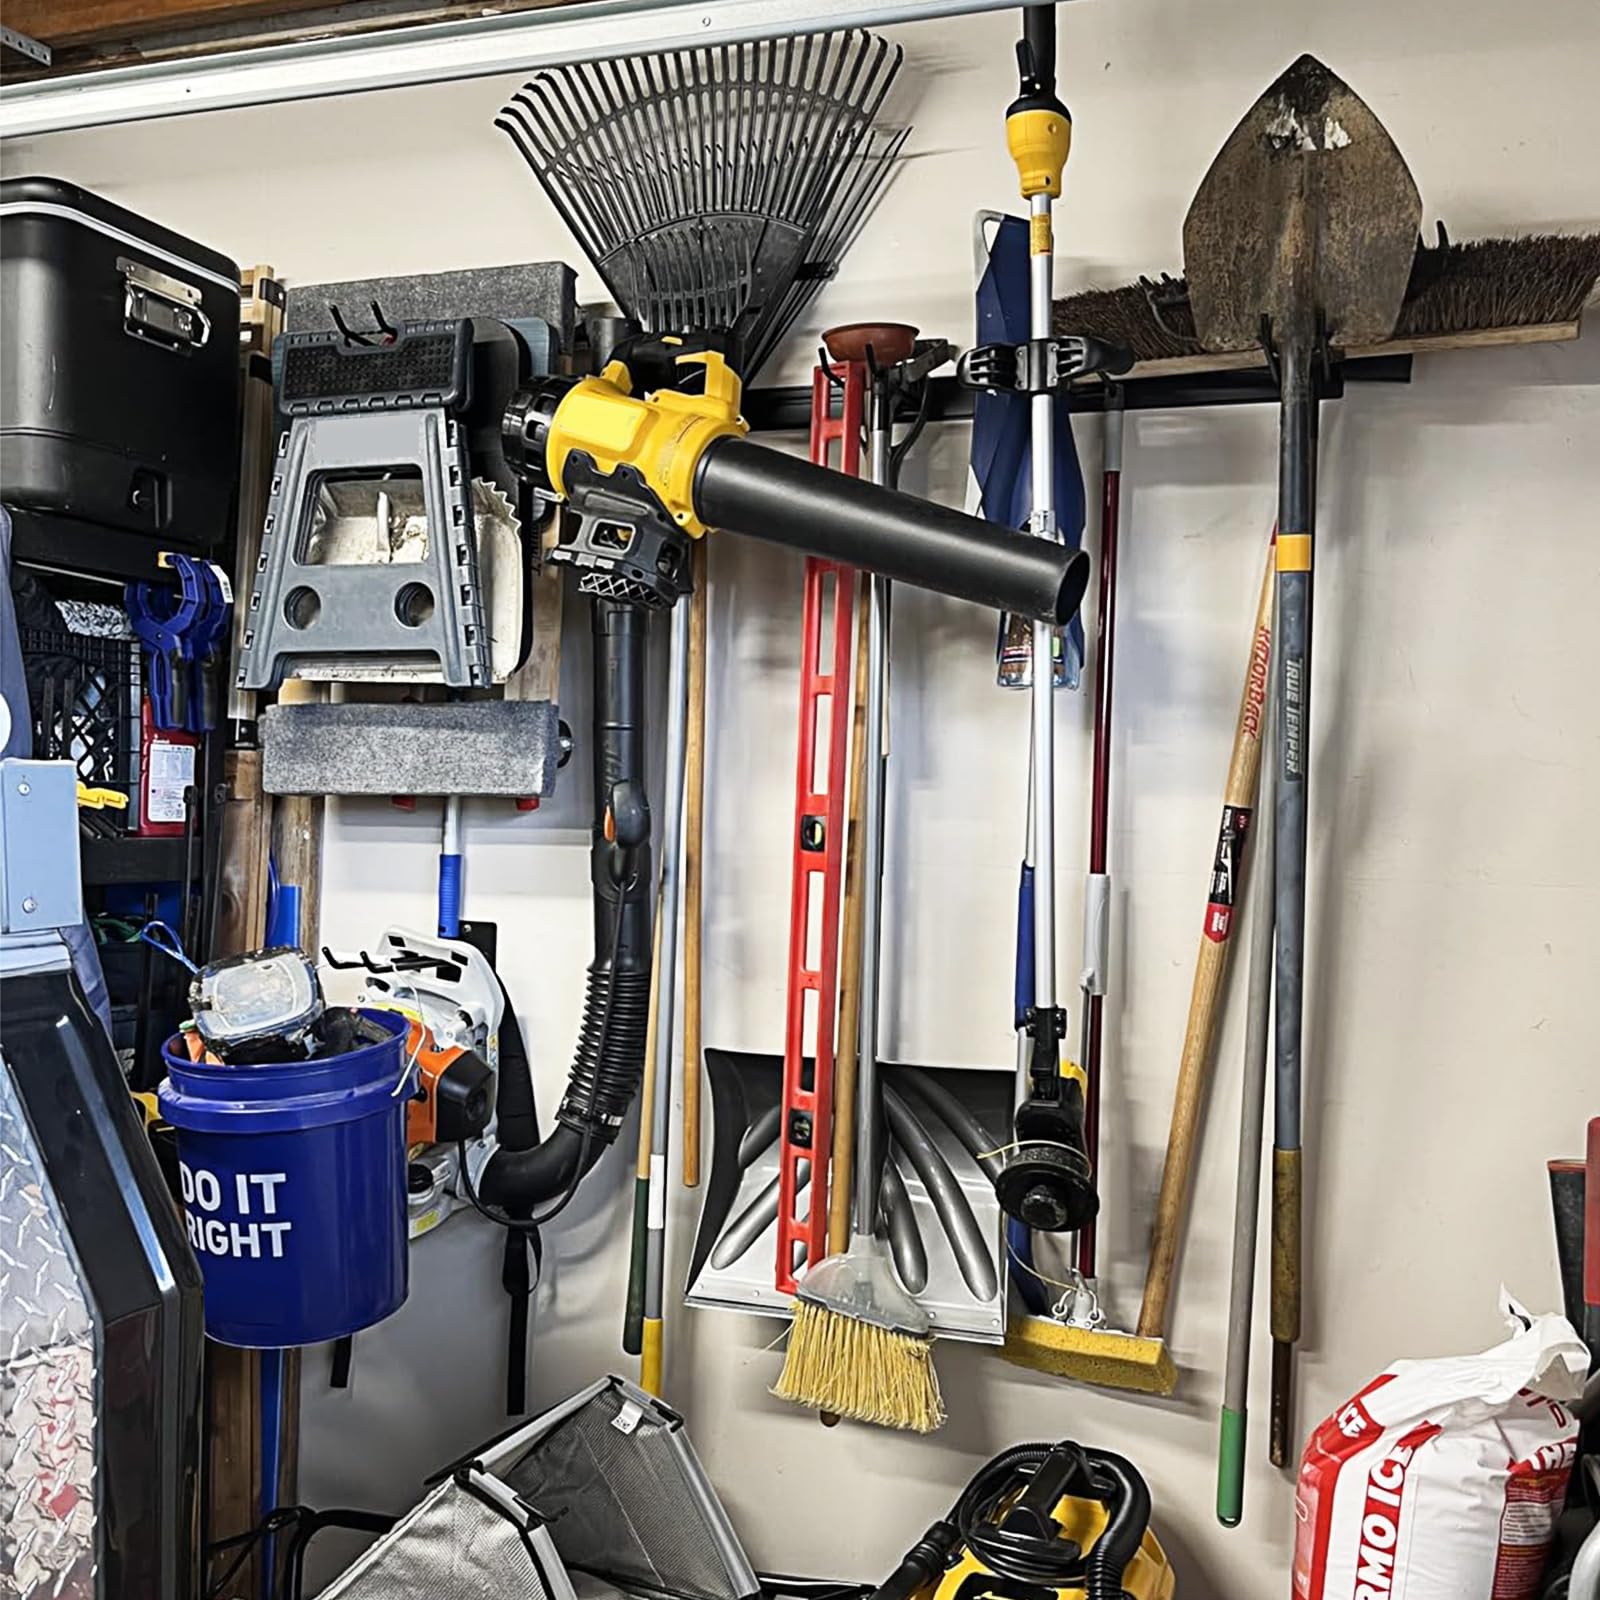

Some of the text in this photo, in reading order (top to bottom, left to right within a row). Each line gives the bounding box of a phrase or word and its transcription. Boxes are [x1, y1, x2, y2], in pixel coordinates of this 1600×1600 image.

[1286, 658, 1304, 774] TRUE TEMPER
[179, 1160, 286, 1214] DO IT
[185, 1208, 291, 1258] RIGHT
[1368, 1444, 1413, 1507] ICE
